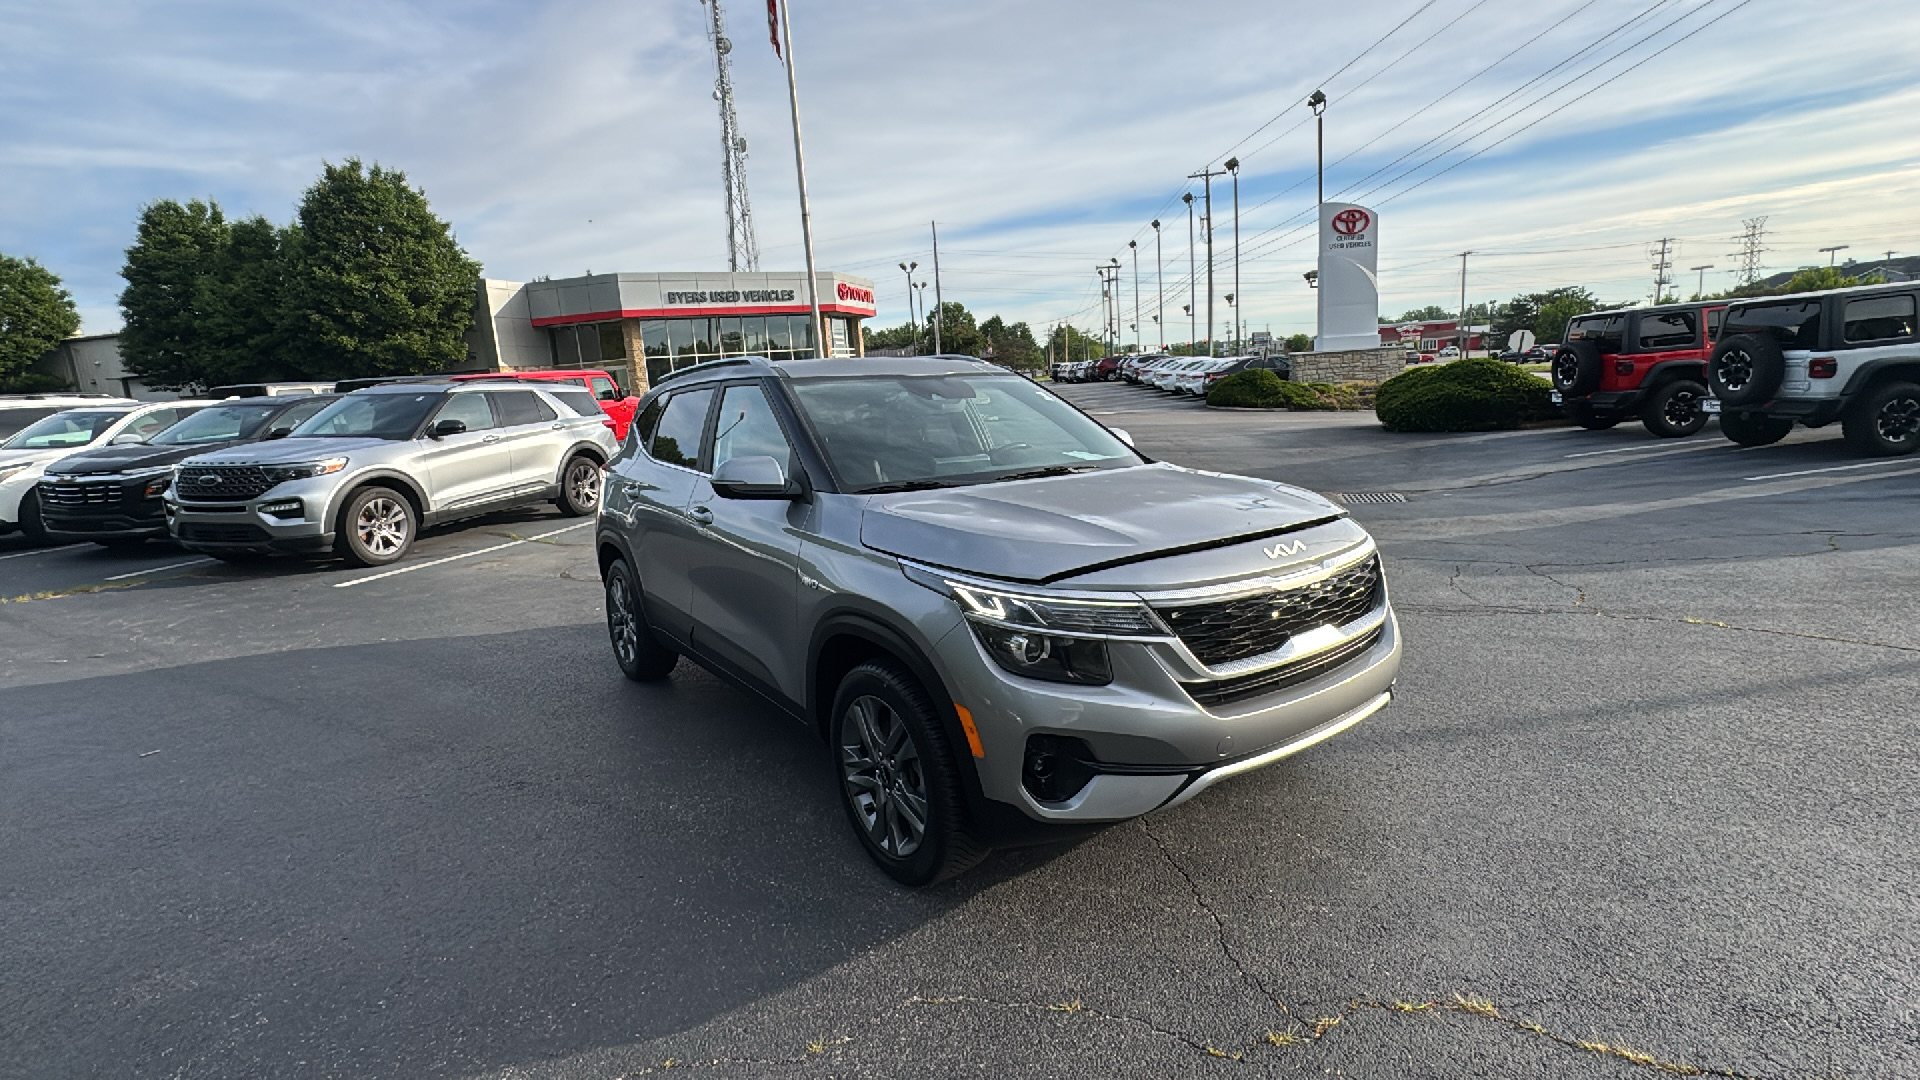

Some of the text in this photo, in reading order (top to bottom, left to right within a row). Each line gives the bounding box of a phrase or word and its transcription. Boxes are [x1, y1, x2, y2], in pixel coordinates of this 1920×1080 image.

[1345, 241, 1372, 249] VEHICLES
[667, 289, 795, 304] BYERS USED VEHICLES
[848, 287, 874, 304] TOYOTA
[1263, 539, 1307, 559] KIA
